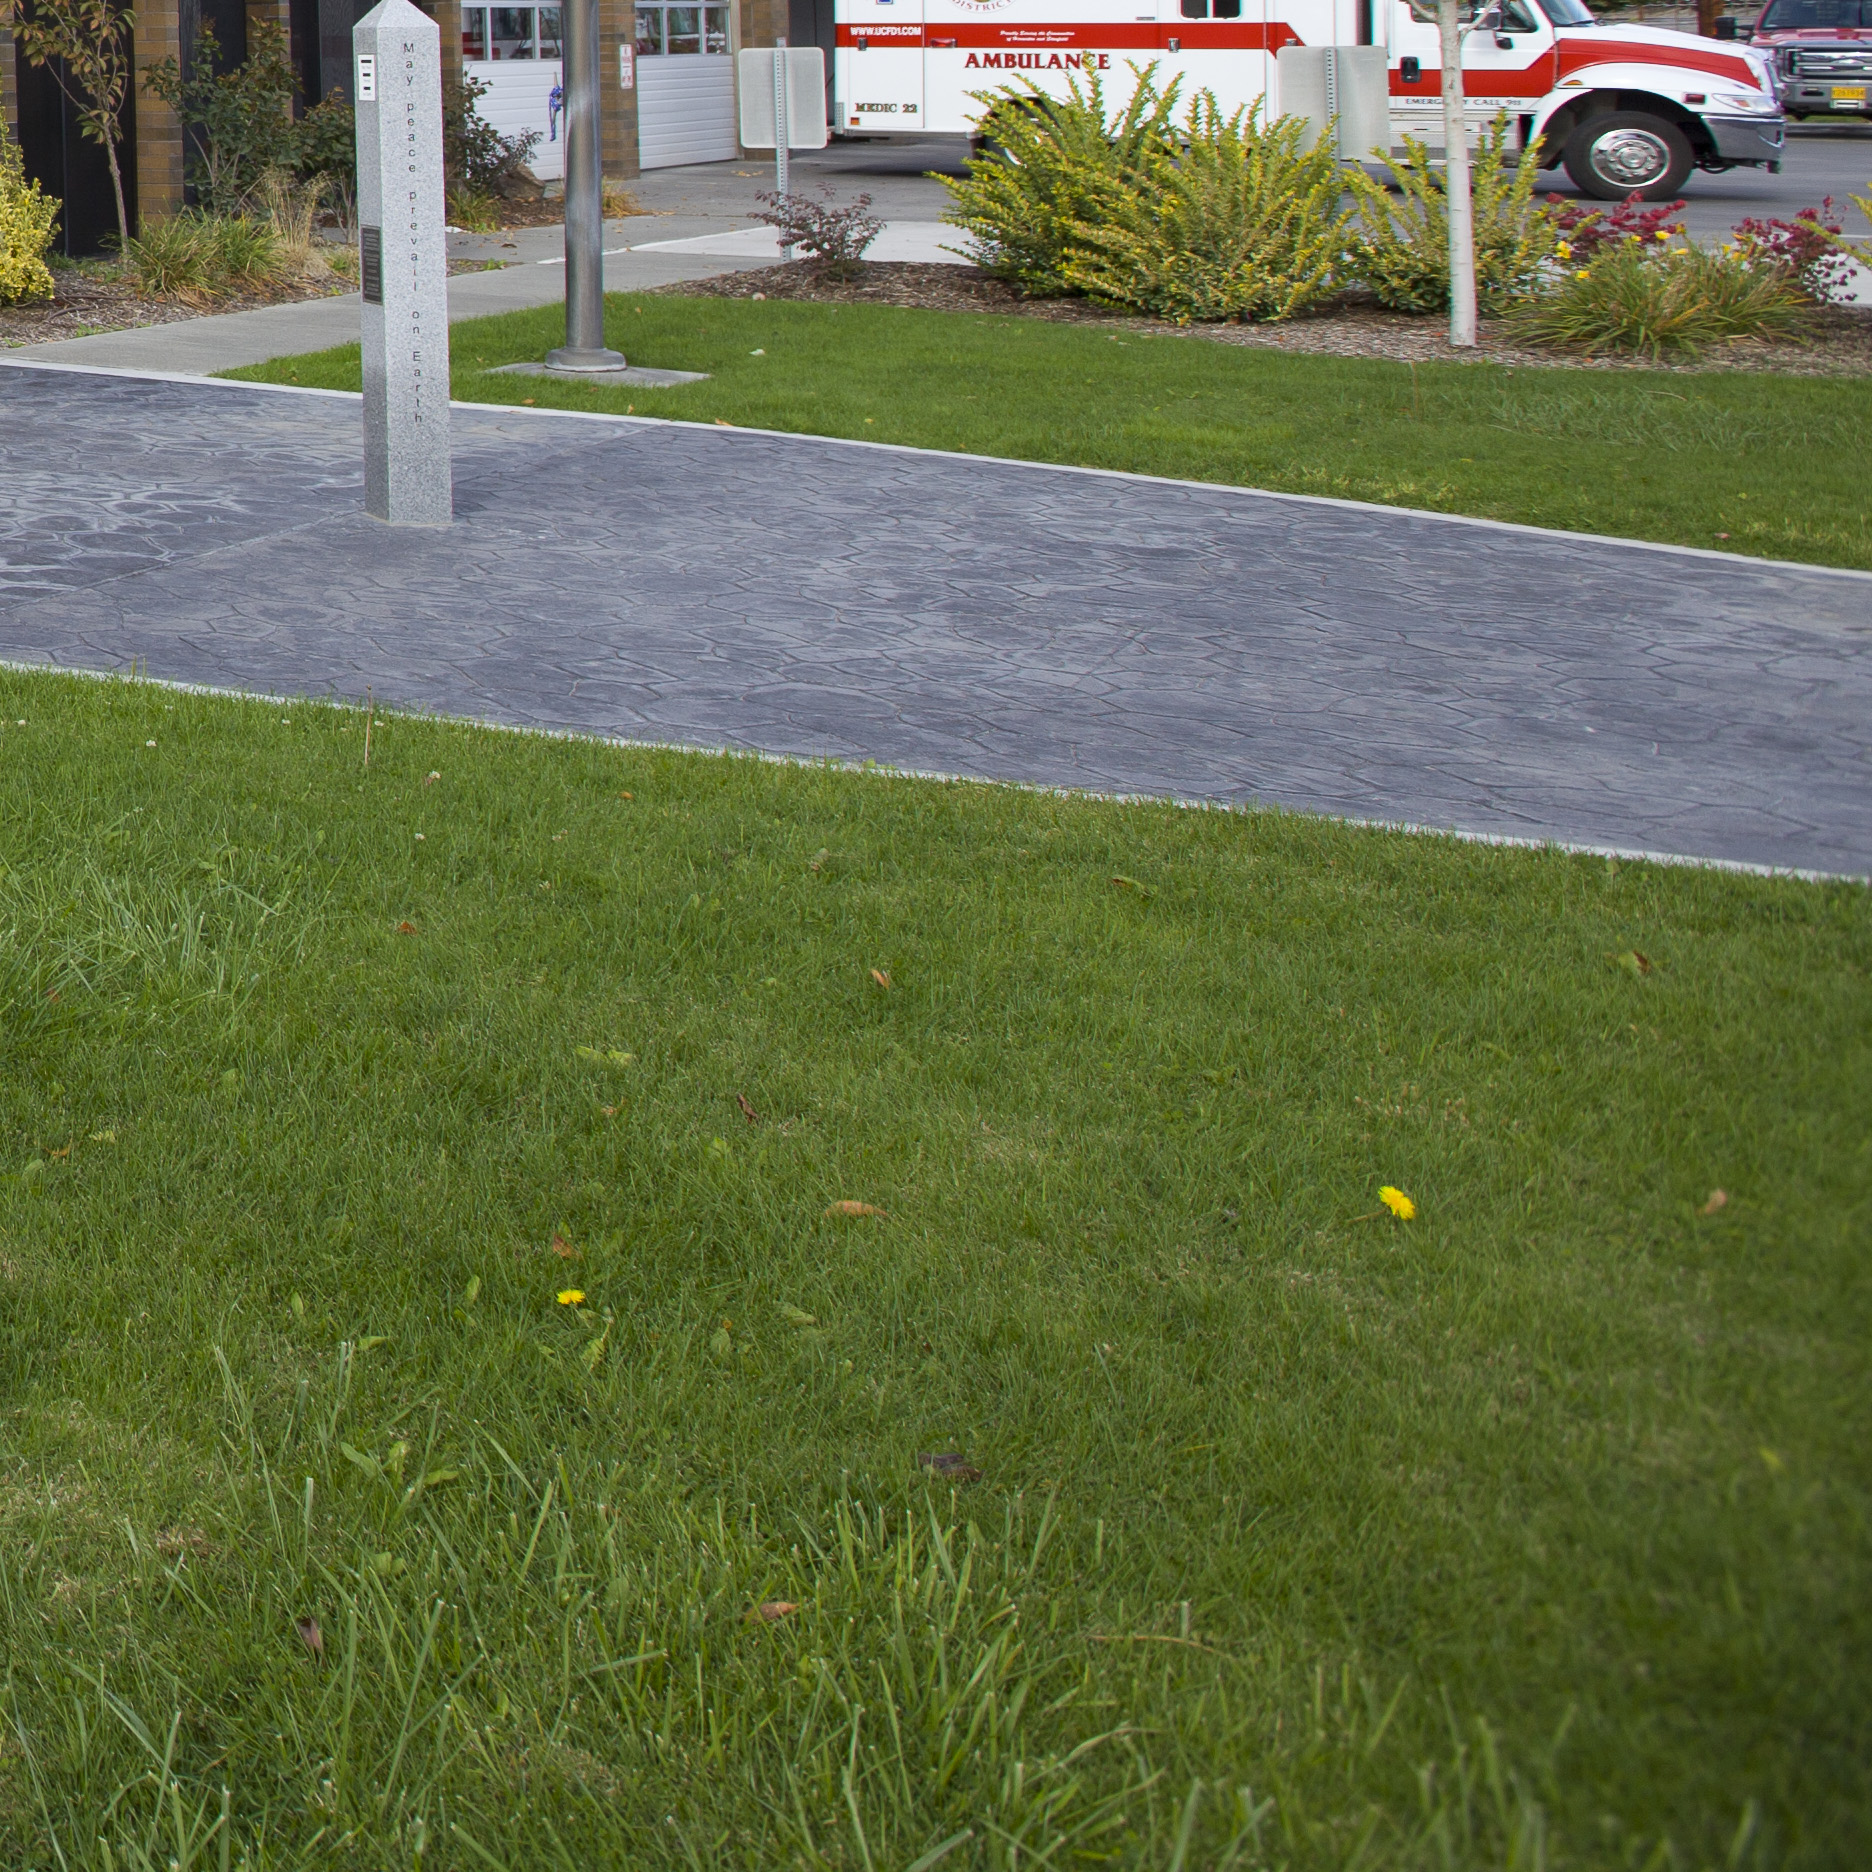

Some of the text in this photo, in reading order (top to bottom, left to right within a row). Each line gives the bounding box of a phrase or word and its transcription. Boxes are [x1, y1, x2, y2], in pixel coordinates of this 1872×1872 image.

[403, 42, 416, 87] May
[854, 102, 898, 113] MEDIC
[406, 101, 417, 174] peace
[408, 189, 419, 293] prevail
[411, 310, 421, 335] on
[412, 351, 424, 424] Earth
